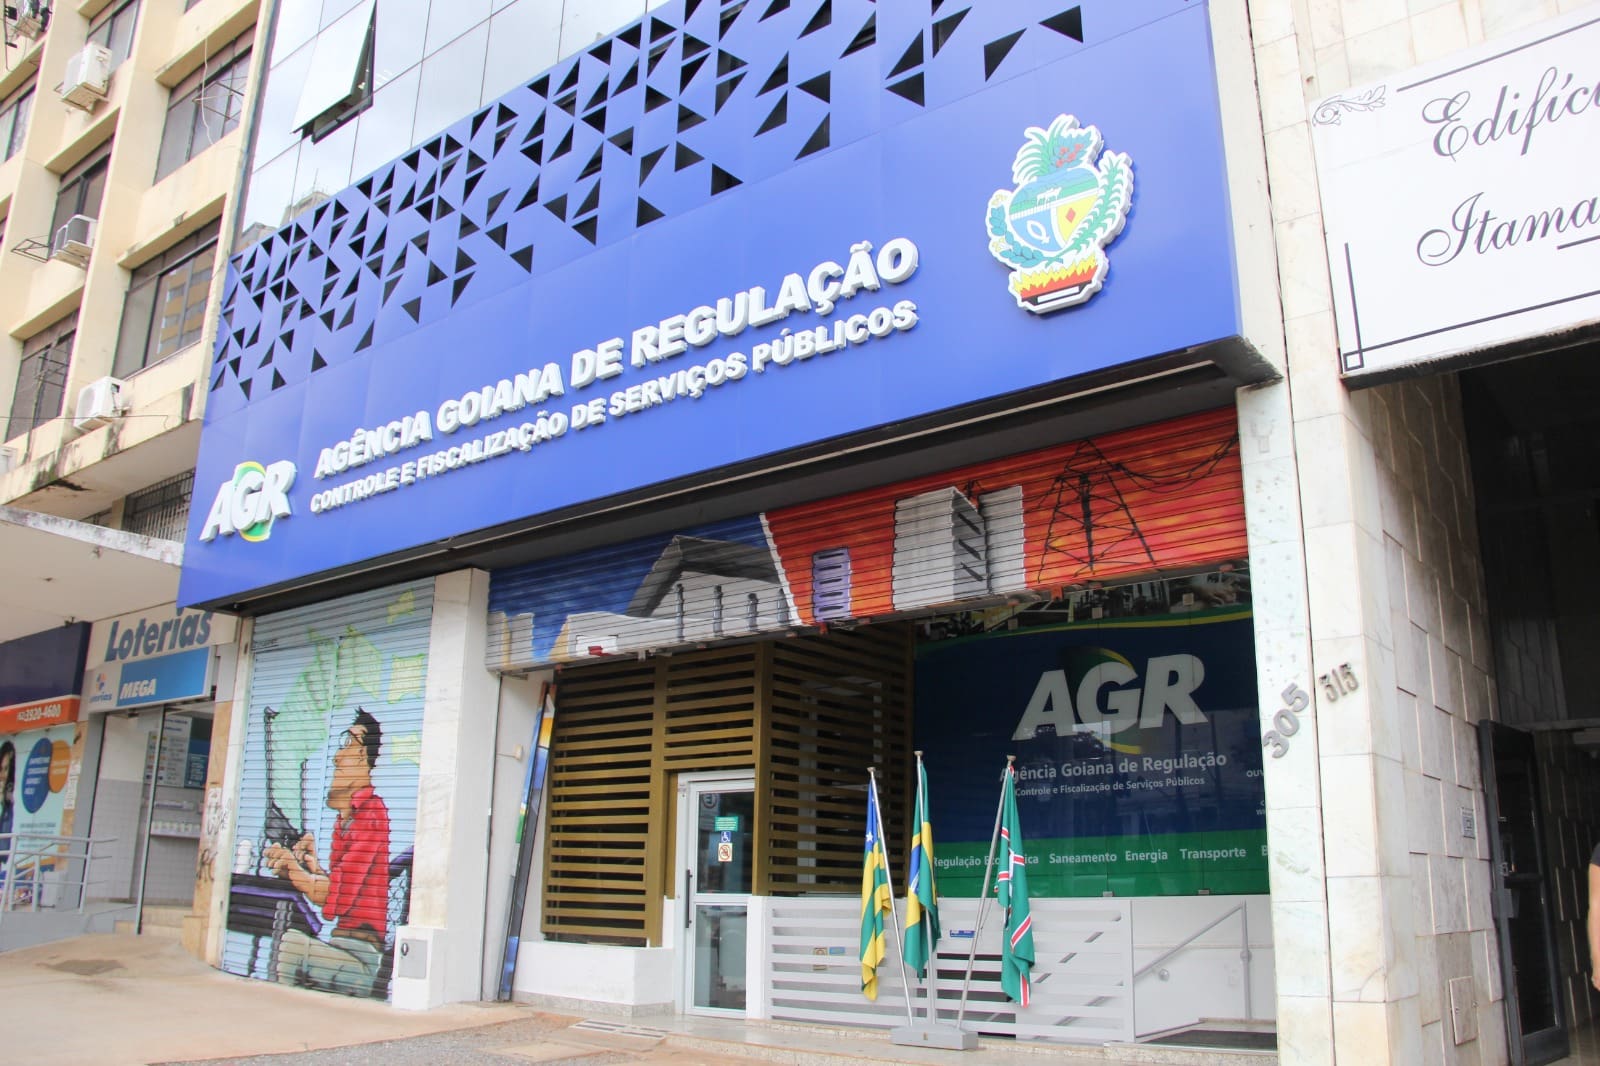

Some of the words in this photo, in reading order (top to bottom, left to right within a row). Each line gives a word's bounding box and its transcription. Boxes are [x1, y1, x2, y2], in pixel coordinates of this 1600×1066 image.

[314, 410, 432, 479] AGÊNCIA
[437, 362, 564, 434] GOIANA
[570, 337, 624, 389] DE
[631, 238, 918, 368] REGULAÇÃO
[310, 466, 400, 513] CONTROLE
[400, 461, 417, 486] E
[416, 410, 568, 479] FISCALIZAÇÃO
[571, 398, 607, 430] DE
[609, 352, 747, 417] SERVIÇOS
[753, 300, 919, 373] PÚBLICOS
[199, 459, 297, 543] AGR
[104, 607, 213, 662] Loterias
[119, 679, 157, 700] MEGA
[1011, 653, 1209, 742] AGR
[1319, 663, 1359, 703] 315
[1262, 682, 1310, 759] 305
[1015, 786, 1051, 797] Controle
[1060, 782, 1110, 794] Fiscalização
[1112, 781, 1124, 791] de
[1126, 778, 1163, 791] Serviços
[1166, 776, 1205, 787] Públicos
[1061, 761, 1114, 778] Goiana
[1118, 757, 1138, 773] de
[1143, 752, 1227, 774] Regulação
[1049, 850, 1117, 864] Saneamento
[1125, 850, 1168, 864] Energia
[1180, 847, 1247, 861] Transporte
